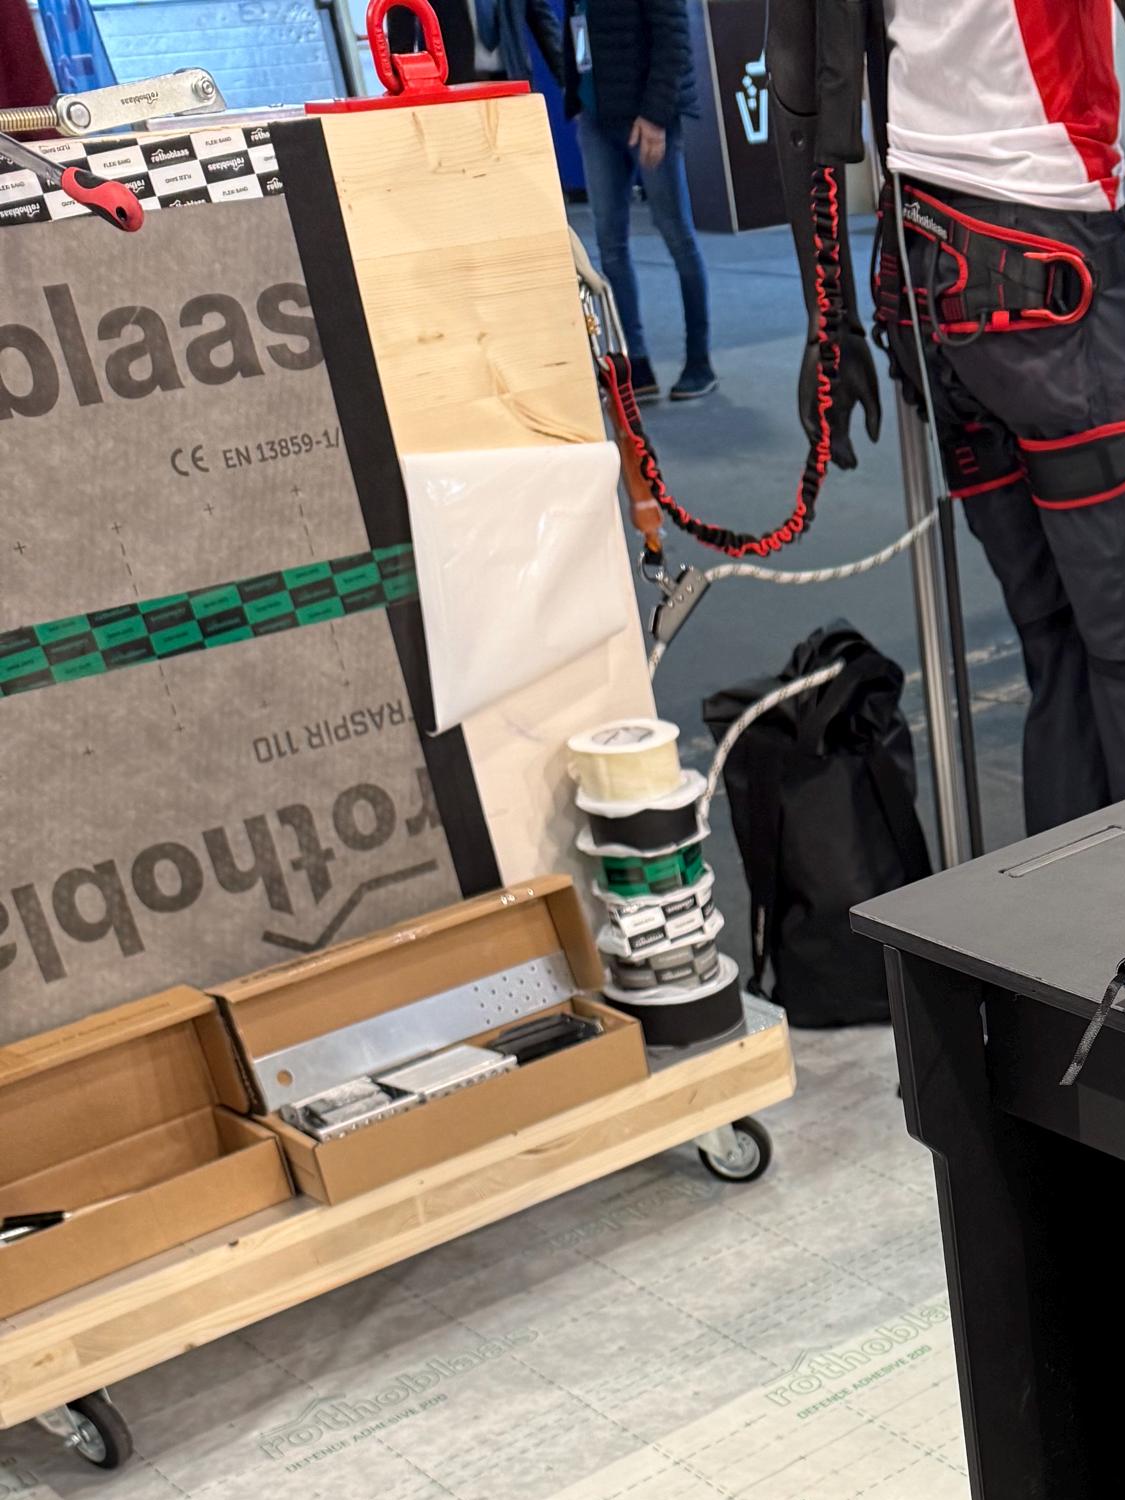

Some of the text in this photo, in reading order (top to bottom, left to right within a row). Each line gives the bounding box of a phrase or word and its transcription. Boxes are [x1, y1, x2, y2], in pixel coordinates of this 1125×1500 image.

[151, 149, 189, 163] rothoblaas
[223, 447, 252, 469] EN
[253, 701, 414, 764] RASPIR 110
[0, 767, 443, 984] rothobl
[765, 1299, 950, 1407] rothobla
[797, 1344, 933, 1420] DEFENCE ADHESIVE 200
[259, 1326, 539, 1461] rothoblaas
[285, 1437, 349, 1473] DEFENCE
[352, 1409, 417, 1443] ADHESIVE
